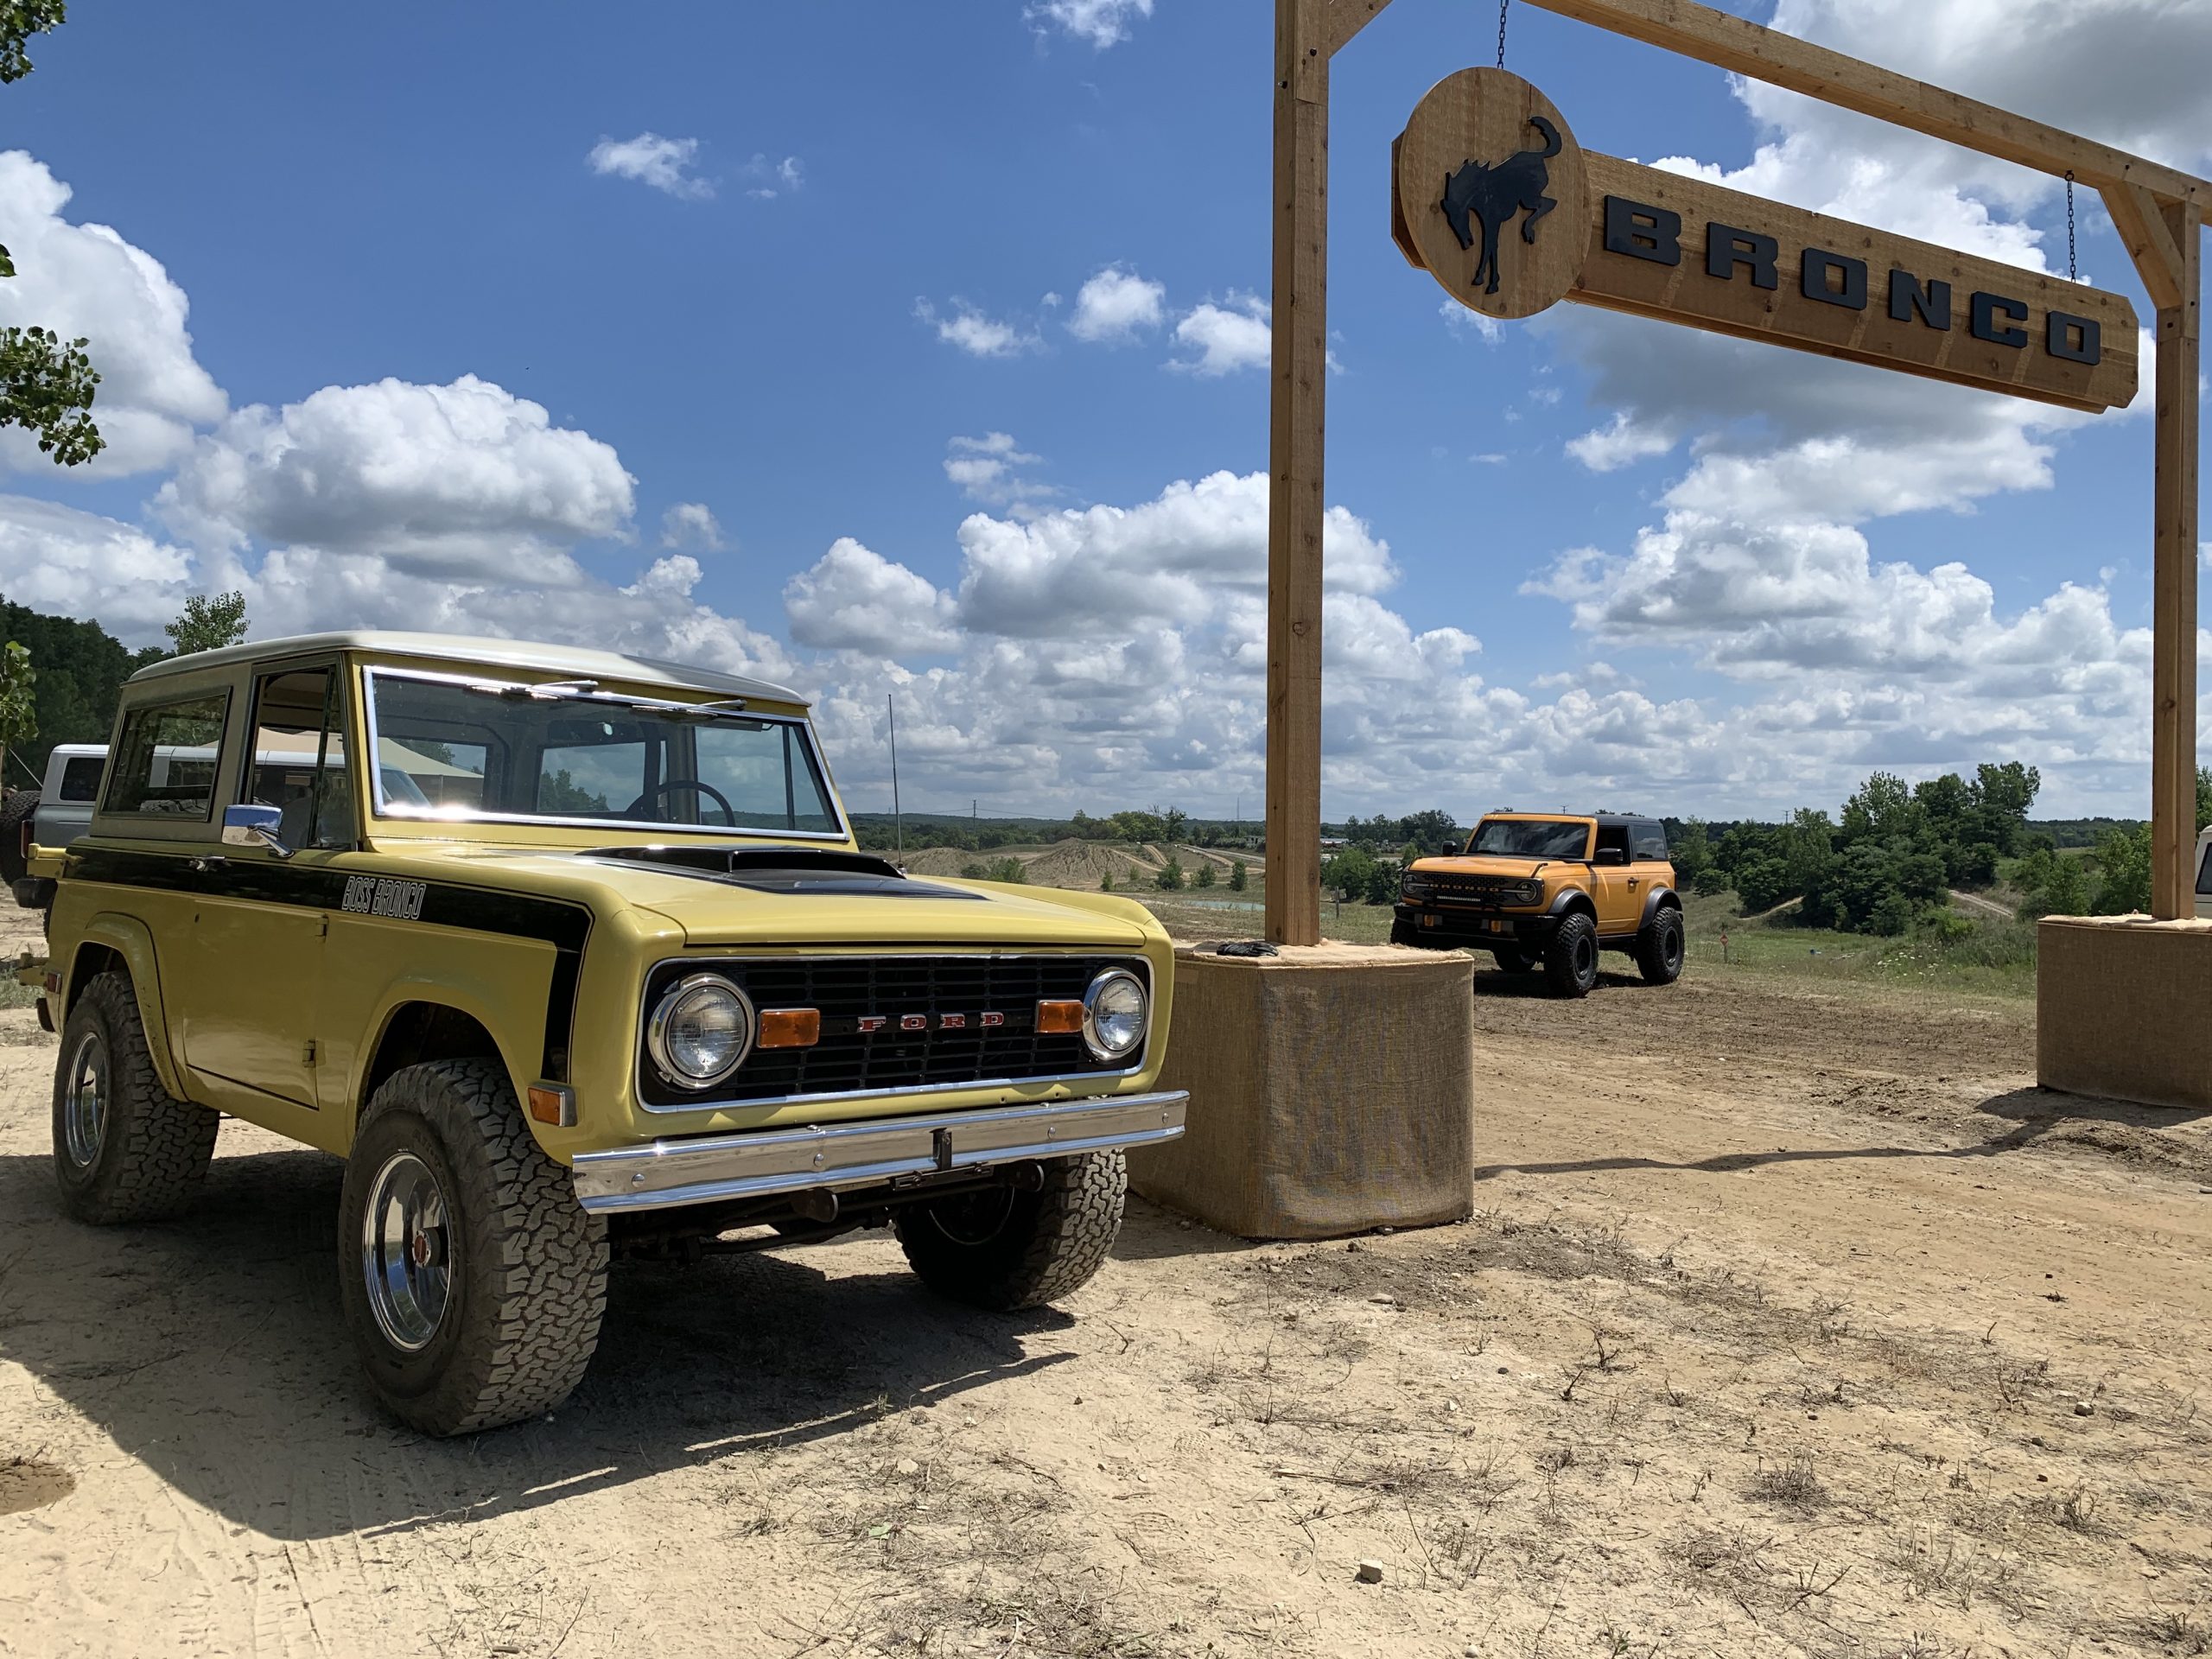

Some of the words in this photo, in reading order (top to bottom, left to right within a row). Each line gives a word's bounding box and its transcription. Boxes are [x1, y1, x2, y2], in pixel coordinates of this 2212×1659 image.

[1604, 194, 2101, 365] BRONCO
[341, 875, 376, 912] BOSS
[372, 879, 427, 920] BRONCO
[856, 1011, 1005, 1033] FORD
